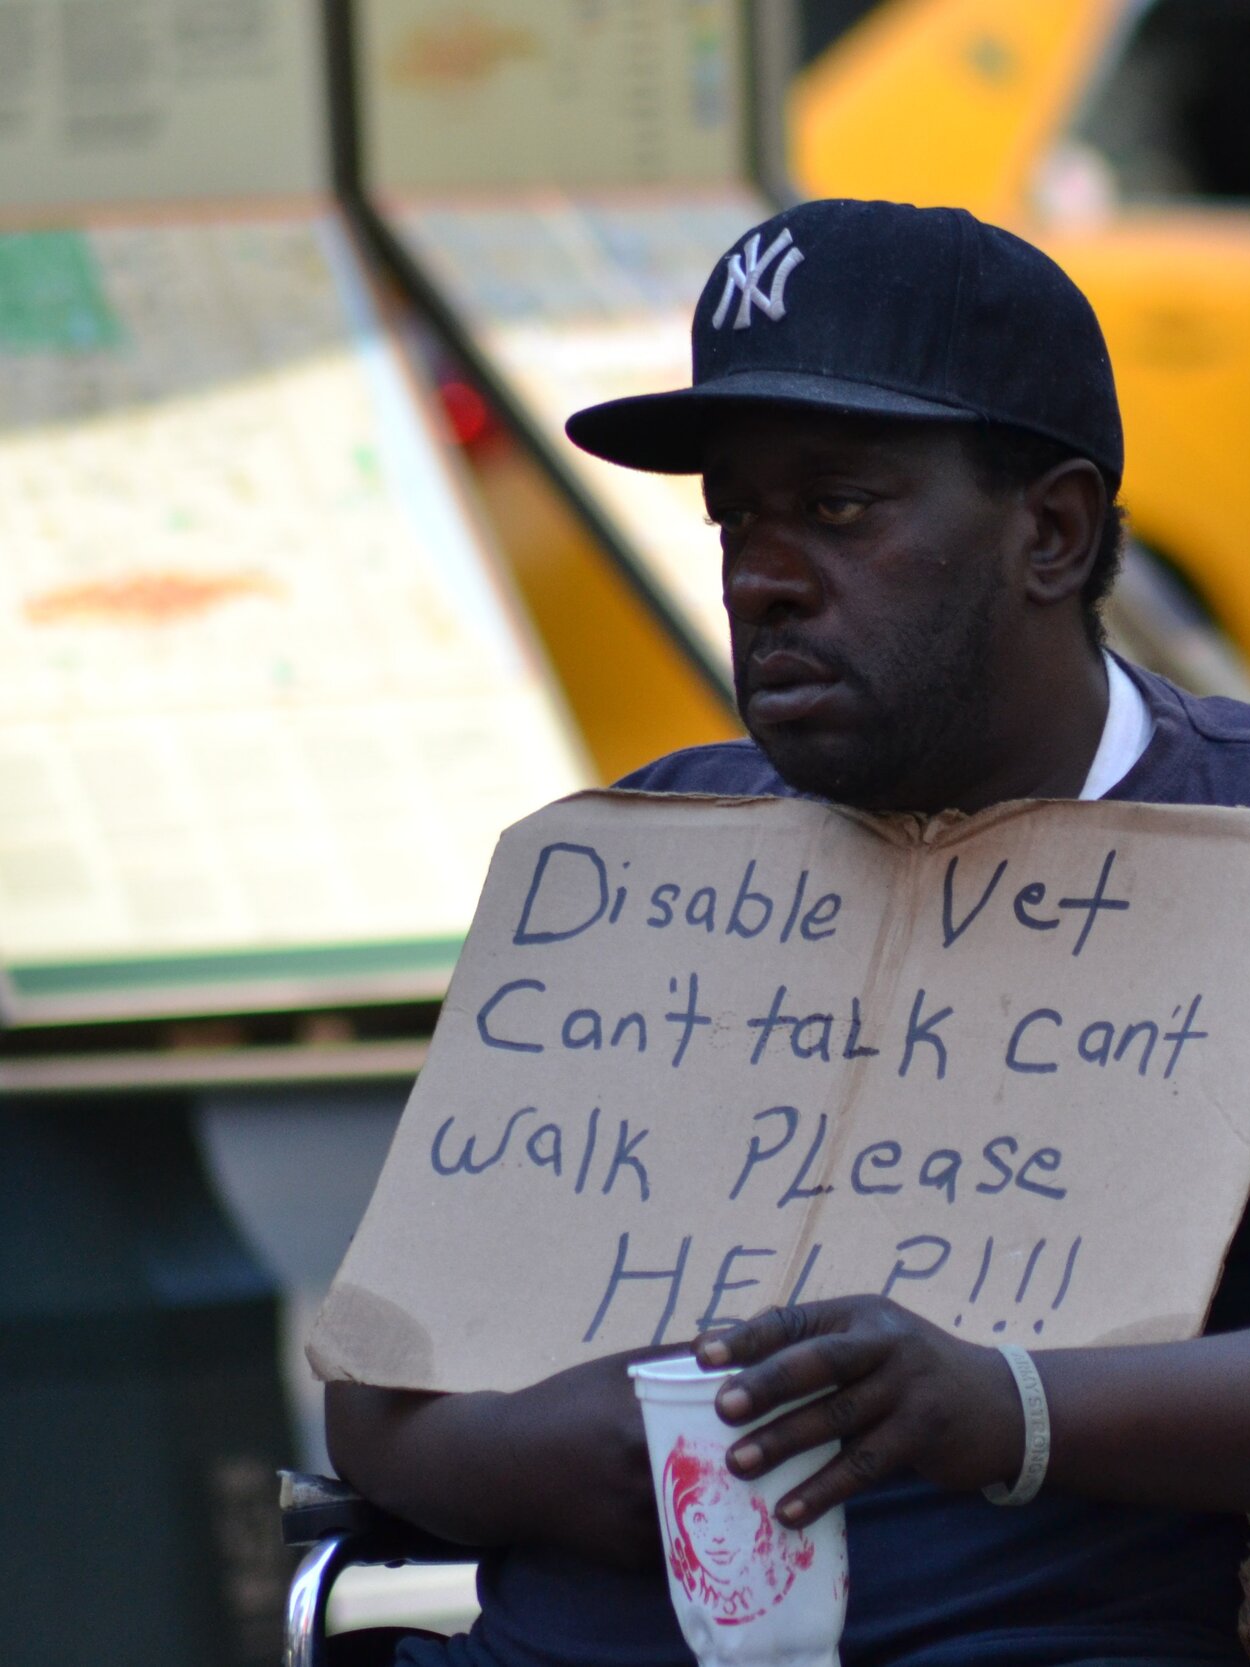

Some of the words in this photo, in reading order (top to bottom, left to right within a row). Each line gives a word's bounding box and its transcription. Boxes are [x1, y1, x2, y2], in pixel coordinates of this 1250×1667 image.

[711, 227, 805, 331] NY
[513, 841, 842, 945] Disable
[942, 849, 1131, 957] Vet
[475, 972, 712, 1068] Can't
